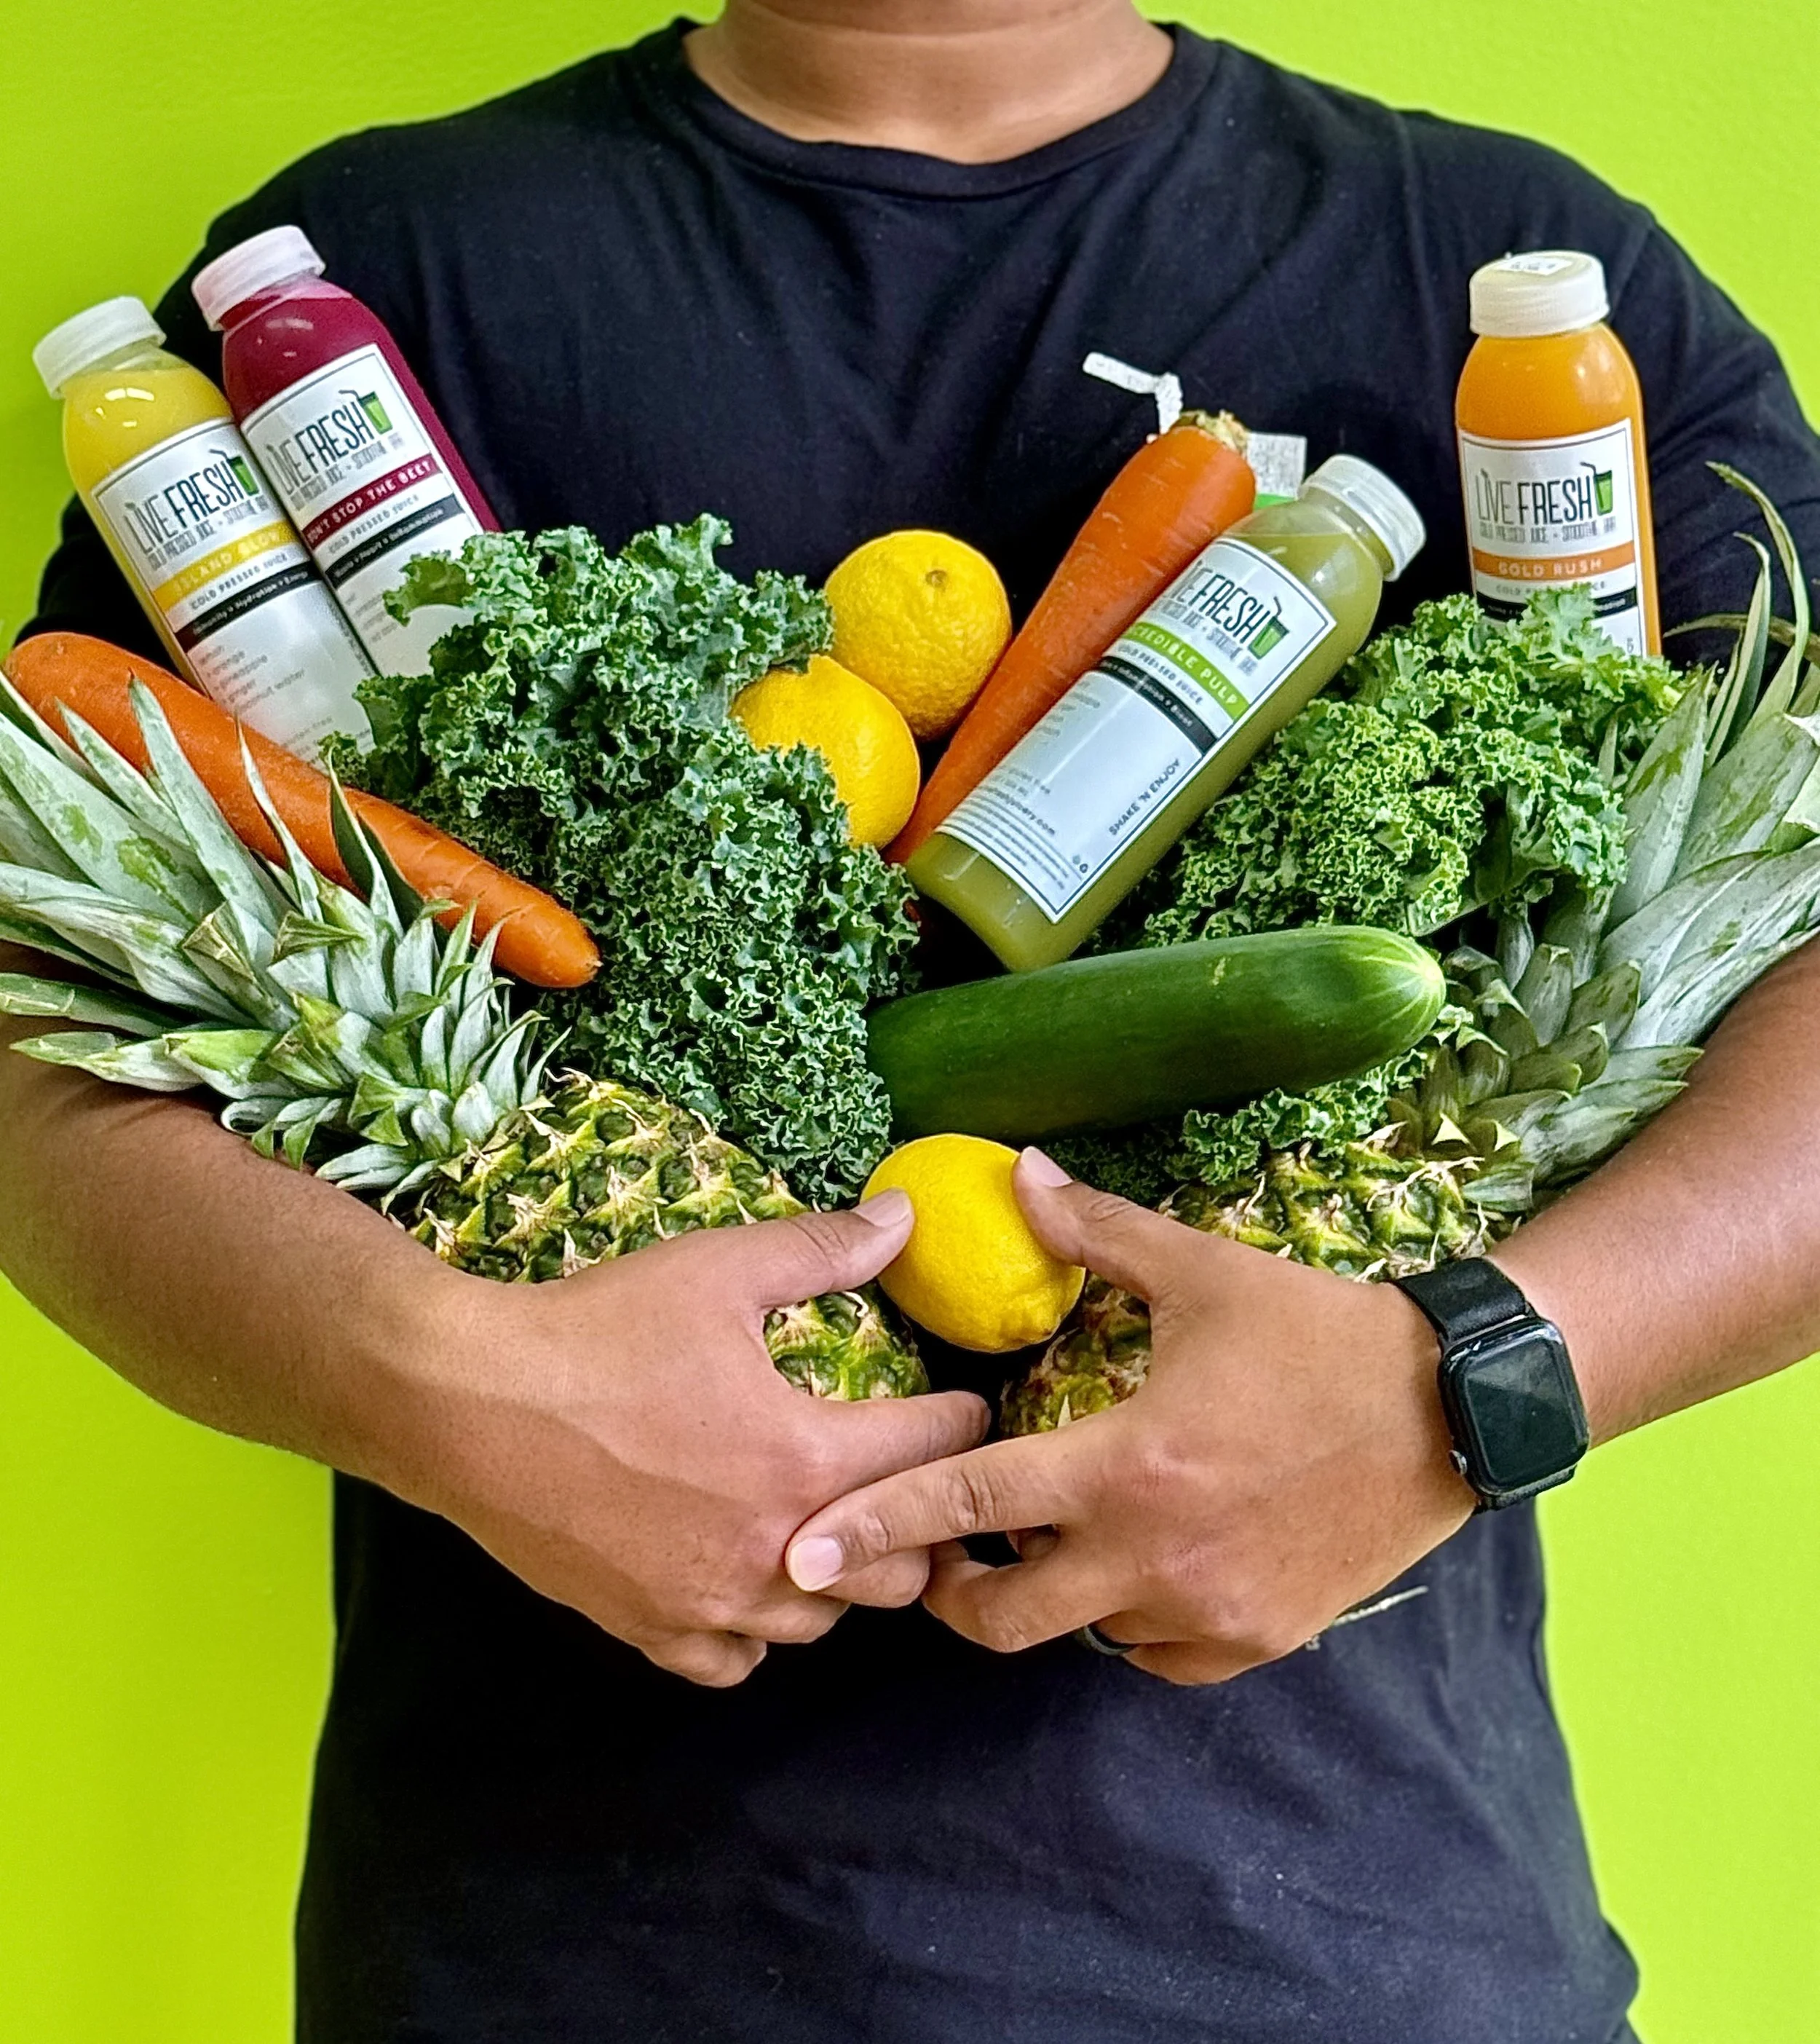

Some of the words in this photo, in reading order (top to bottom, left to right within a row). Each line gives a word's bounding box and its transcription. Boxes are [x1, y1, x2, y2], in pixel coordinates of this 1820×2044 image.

[293, 400, 374, 473] FRESH
[123, 494, 176, 553] LIVE
[163, 459, 244, 529] FRESH
[331, 497, 364, 524] STOP
[366, 478, 396, 502] THE
[398, 460, 431, 485] BEET
[1475, 468, 1511, 524] LIVE
[1518, 475, 1593, 525] FRESH
[190, 588, 217, 610] COLD
[218, 564, 261, 593] PRESSED
[1498, 562, 1543, 577] GOLD
[1554, 559, 1602, 575] RUSH
[1189, 570, 1270, 644] FRESH
[1199, 668, 1238, 707] PULP
[1107, 802, 1141, 836] SHAKE
[1149, 757, 1182, 793] ENJOY
